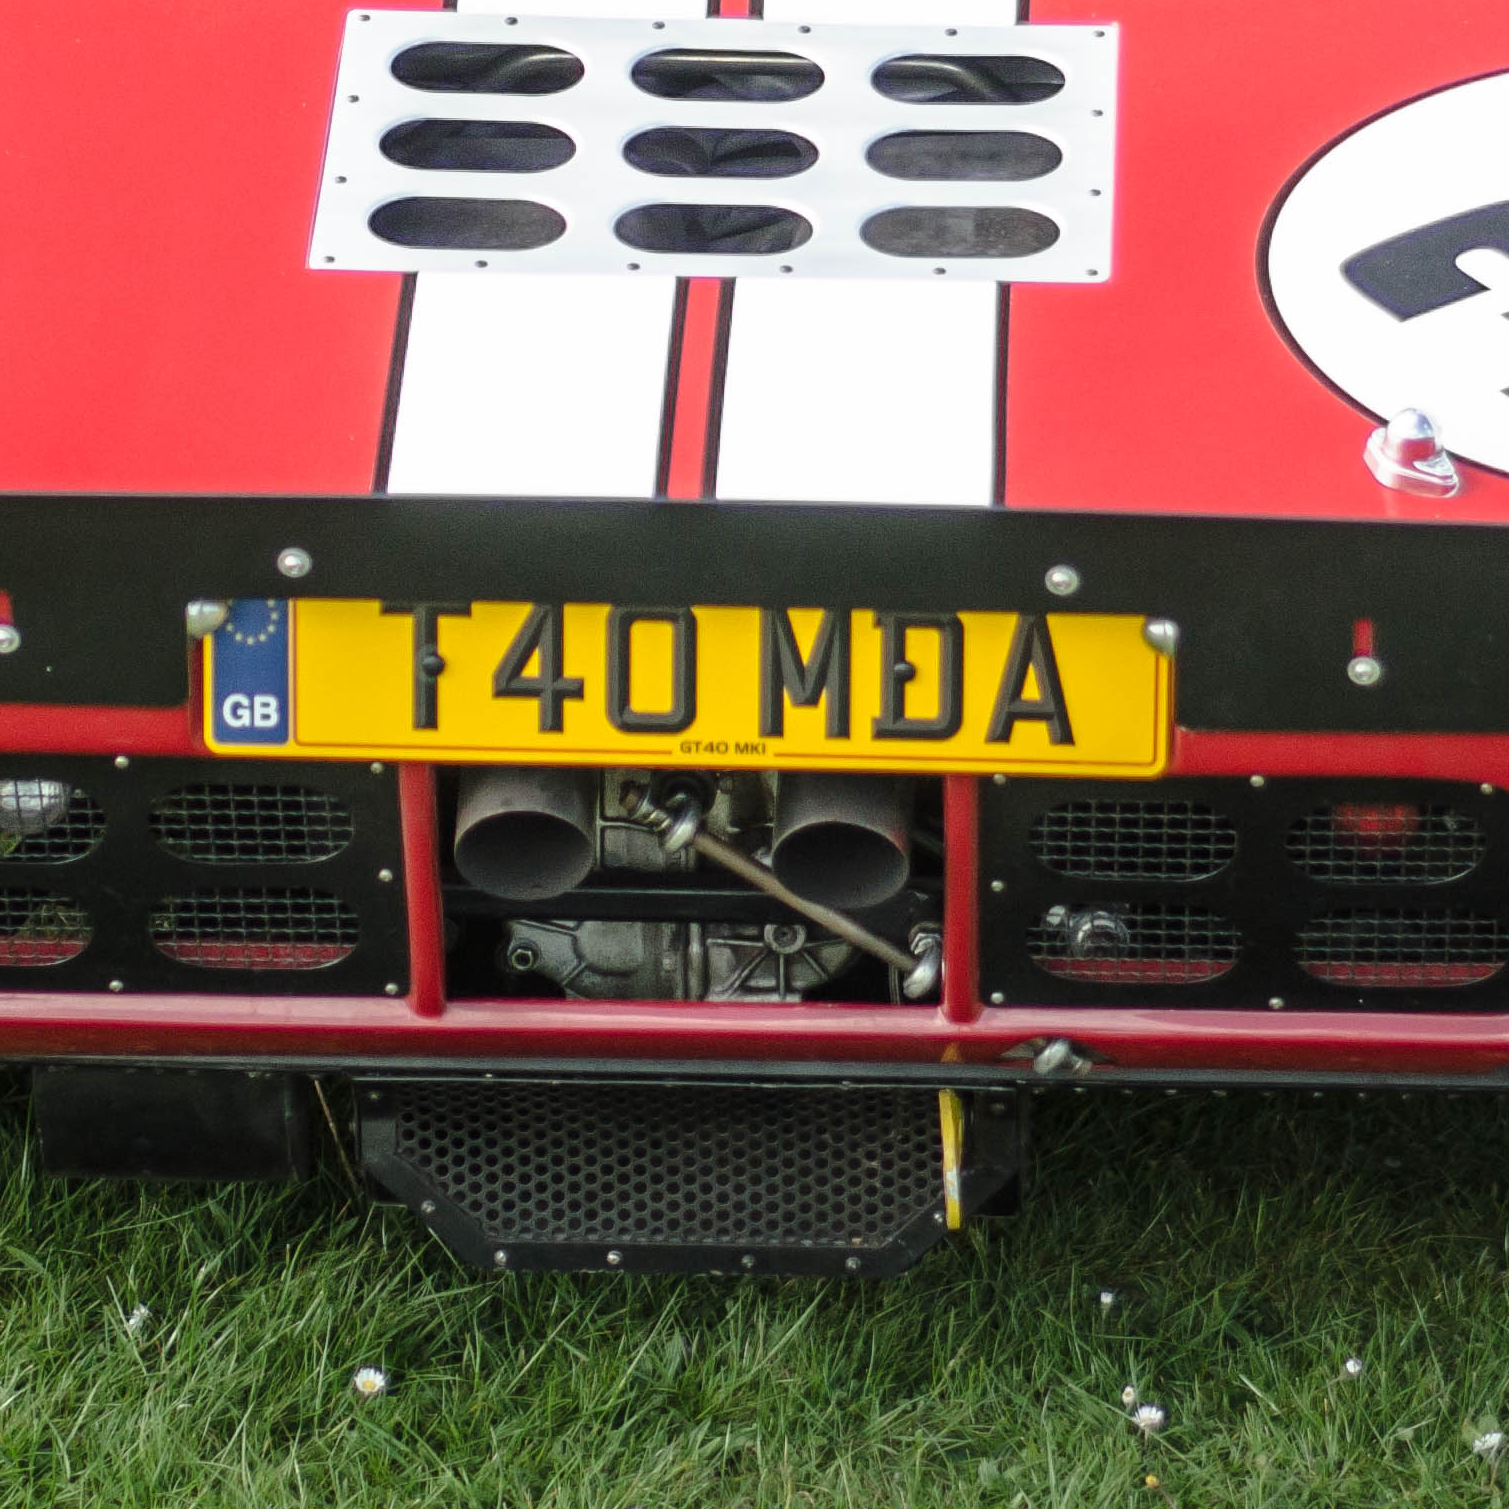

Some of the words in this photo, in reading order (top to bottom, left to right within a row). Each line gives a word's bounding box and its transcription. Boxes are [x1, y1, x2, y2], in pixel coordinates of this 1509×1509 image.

[379, 598, 698, 735] T40
[758, 608, 1076, 746] MDA
[222, 693, 280, 728] GB
[679, 740, 729, 755] GT40
[734, 742, 767, 756] MKI
